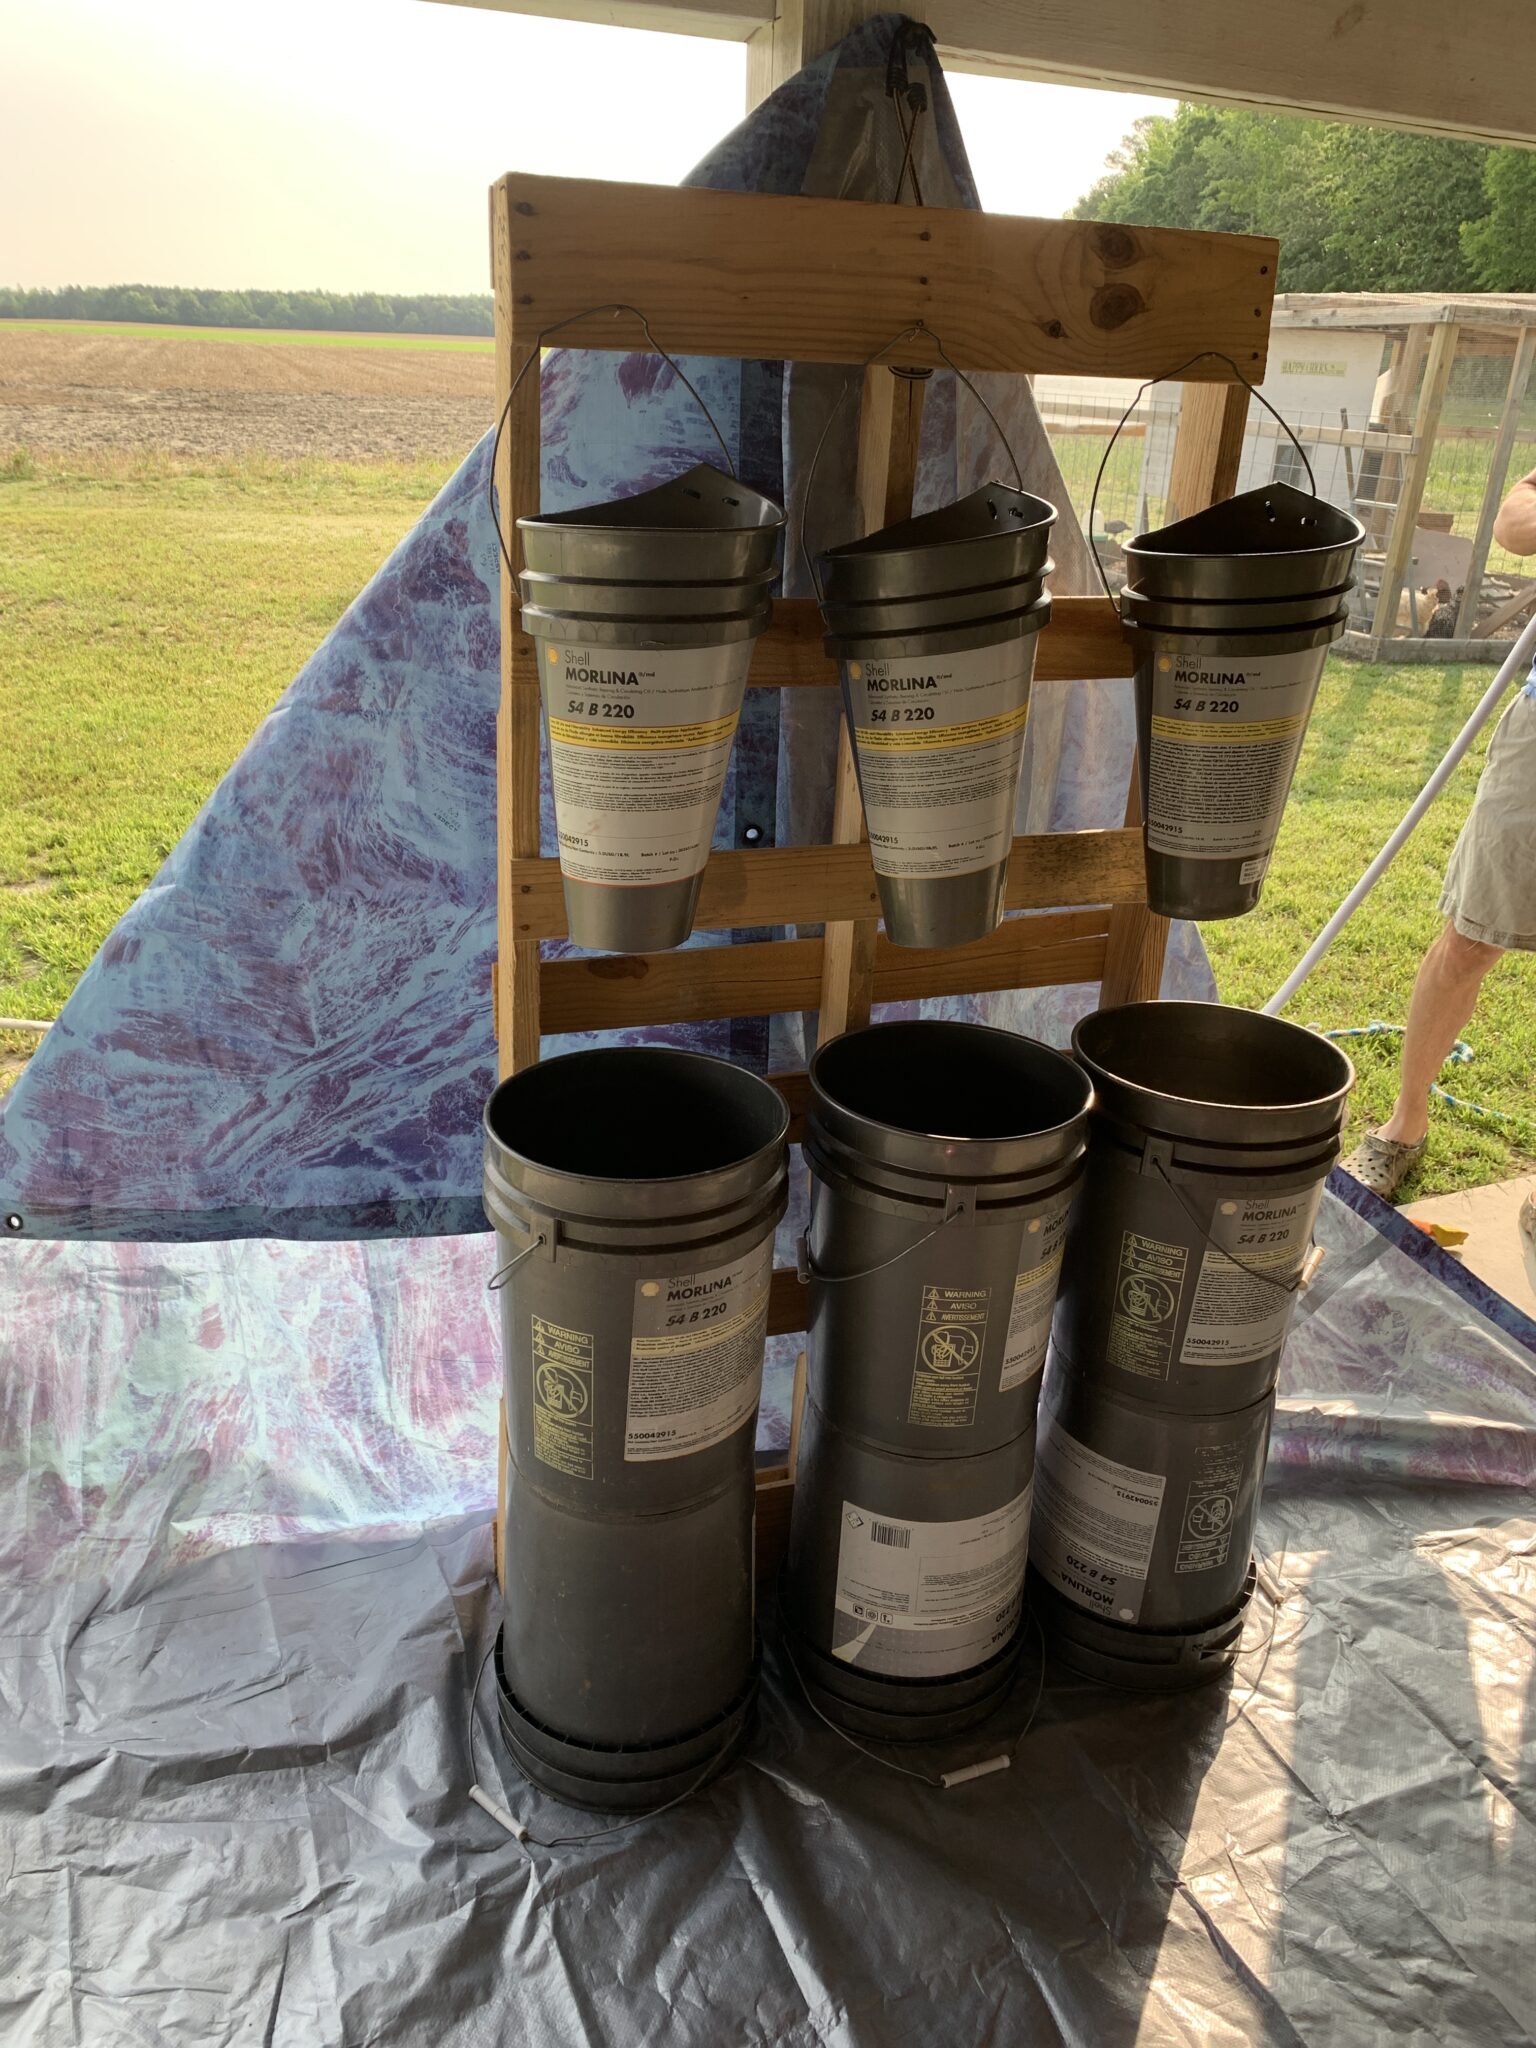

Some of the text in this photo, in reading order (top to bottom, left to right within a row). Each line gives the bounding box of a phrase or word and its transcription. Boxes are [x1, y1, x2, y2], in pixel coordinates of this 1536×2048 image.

[565, 650, 590, 666] Shell
[1175, 656, 1202, 669] Shell
[565, 667, 639, 685] MORLINA
[865, 662, 890, 676] Shell
[867, 676, 937, 691] MORLINA
[1174, 670, 1246, 685] MORLINA
[567, 700, 635, 718] S4 B 220
[1173, 698, 1239, 713] S4 B 220
[871, 706, 935, 722] S4 B 220
[1245, 1199, 1270, 1210] Shell
[1242, 1206, 1297, 1221] MORLINA
[1237, 1228, 1290, 1244] S4 B 220
[1141, 1239, 1183, 1257] WARNING
[1146, 1253, 1173, 1266] AVISO
[668, 1272, 696, 1289] Shell
[666, 1276, 732, 1302] MORLINA
[944, 1290, 987, 1299] WARNING
[950, 1302, 977, 1310] AVISO
[665, 1314, 686, 1327] S4
[689, 1311, 700, 1323] B
[702, 1302, 728, 1320] 220
[547, 1325, 589, 1345] WARNING
[554, 1340, 581, 1355] AVISO
[628, 1429, 677, 1440] 550042915
[1066, 1555, 1118, 1586] S4 B 220
[1061, 1571, 1114, 1606] MORLINA
